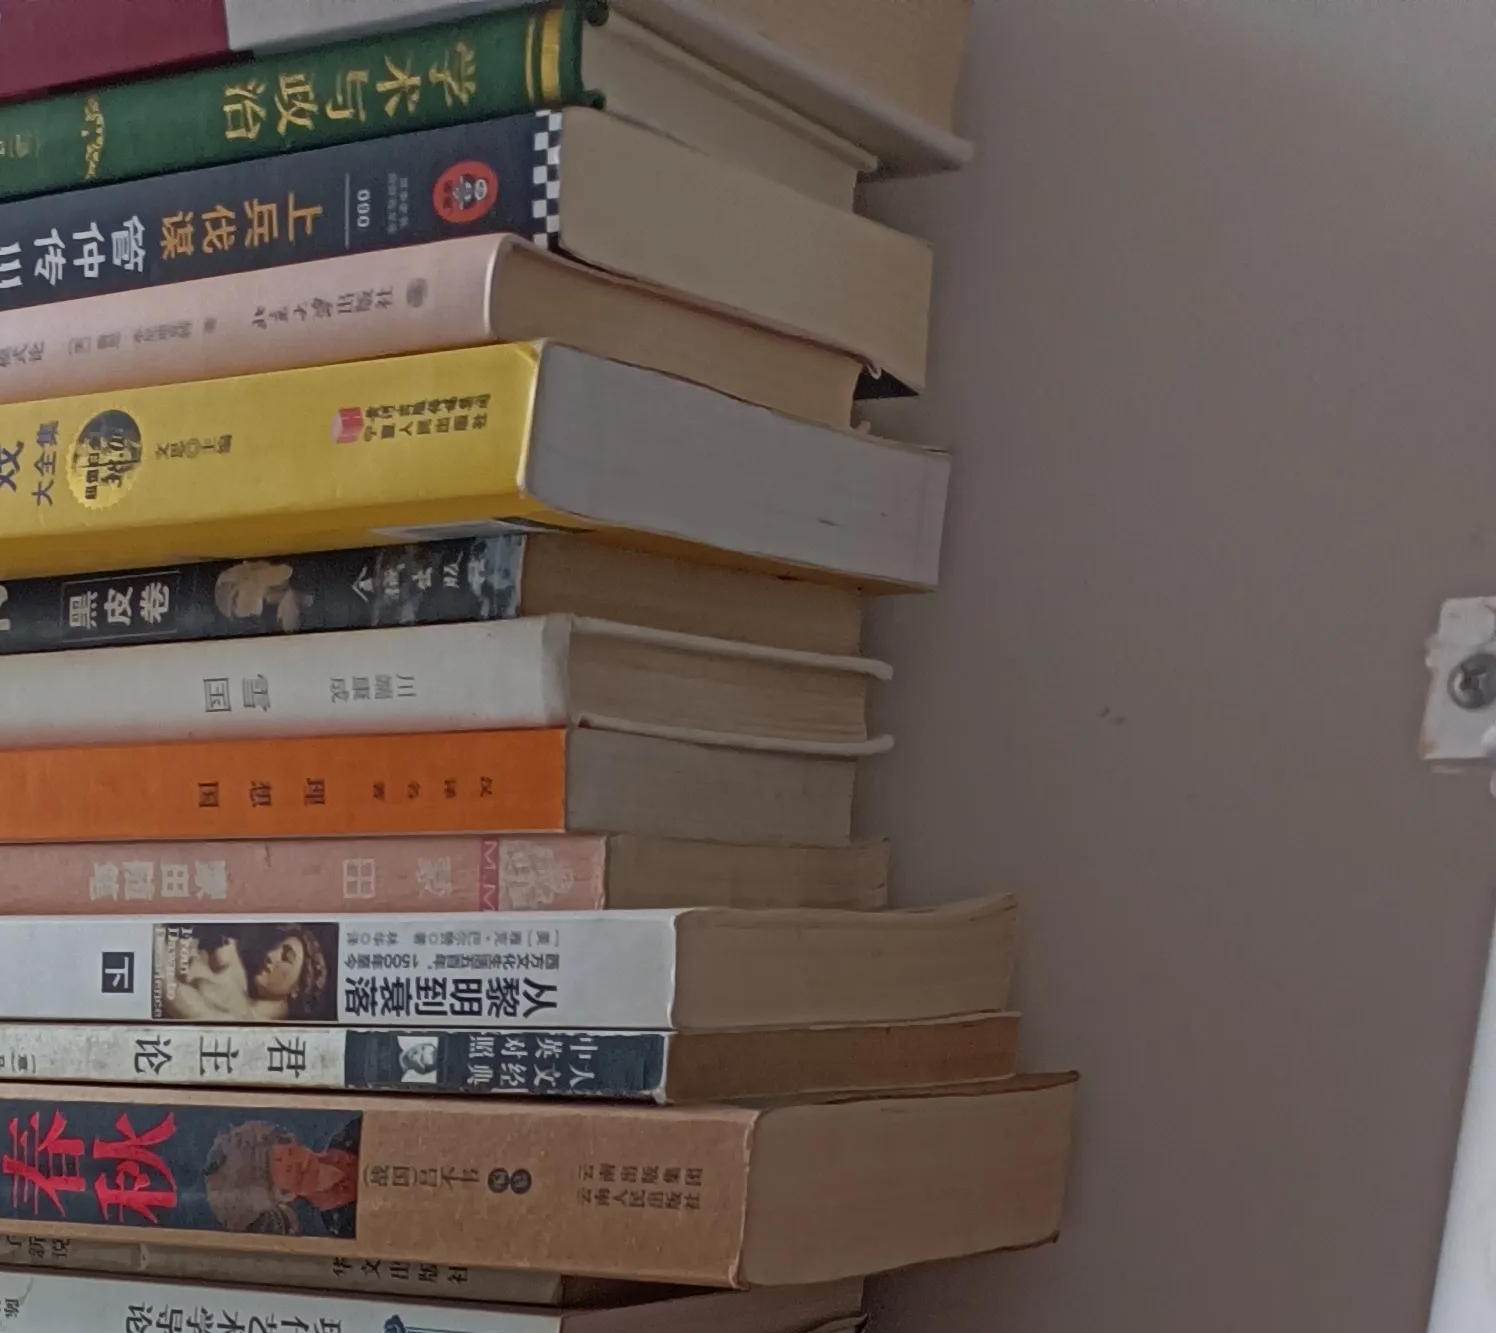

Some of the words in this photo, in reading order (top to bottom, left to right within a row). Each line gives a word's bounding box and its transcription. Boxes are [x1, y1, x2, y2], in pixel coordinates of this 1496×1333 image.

[223, 42, 478, 142] 学术与政治
[159, 192, 325, 261] 上兵伐谋
[355, 188, 372, 230] 090
[33, 213, 147, 285] 管仲传
[31, 419, 62, 507] 大全集
[67, 581, 170, 630] 黑皮卷
[203, 673, 272, 713] 雪国
[197, 777, 327, 810] 理想国
[105, 955, 129, 989] 下
[345, 975, 560, 1020] 从黎明到衰落
[132, 1033, 308, 1079] 君主论
[466, 1033, 601, 1061] 中英对照
[466, 1061, 600, 1089] 人文经典
[579, 1163, 703, 1188] 云南出版集团
[576, 1189, 701, 1210] 云南人民出版社
[332, 1256, 469, 1285] 华文出版社
